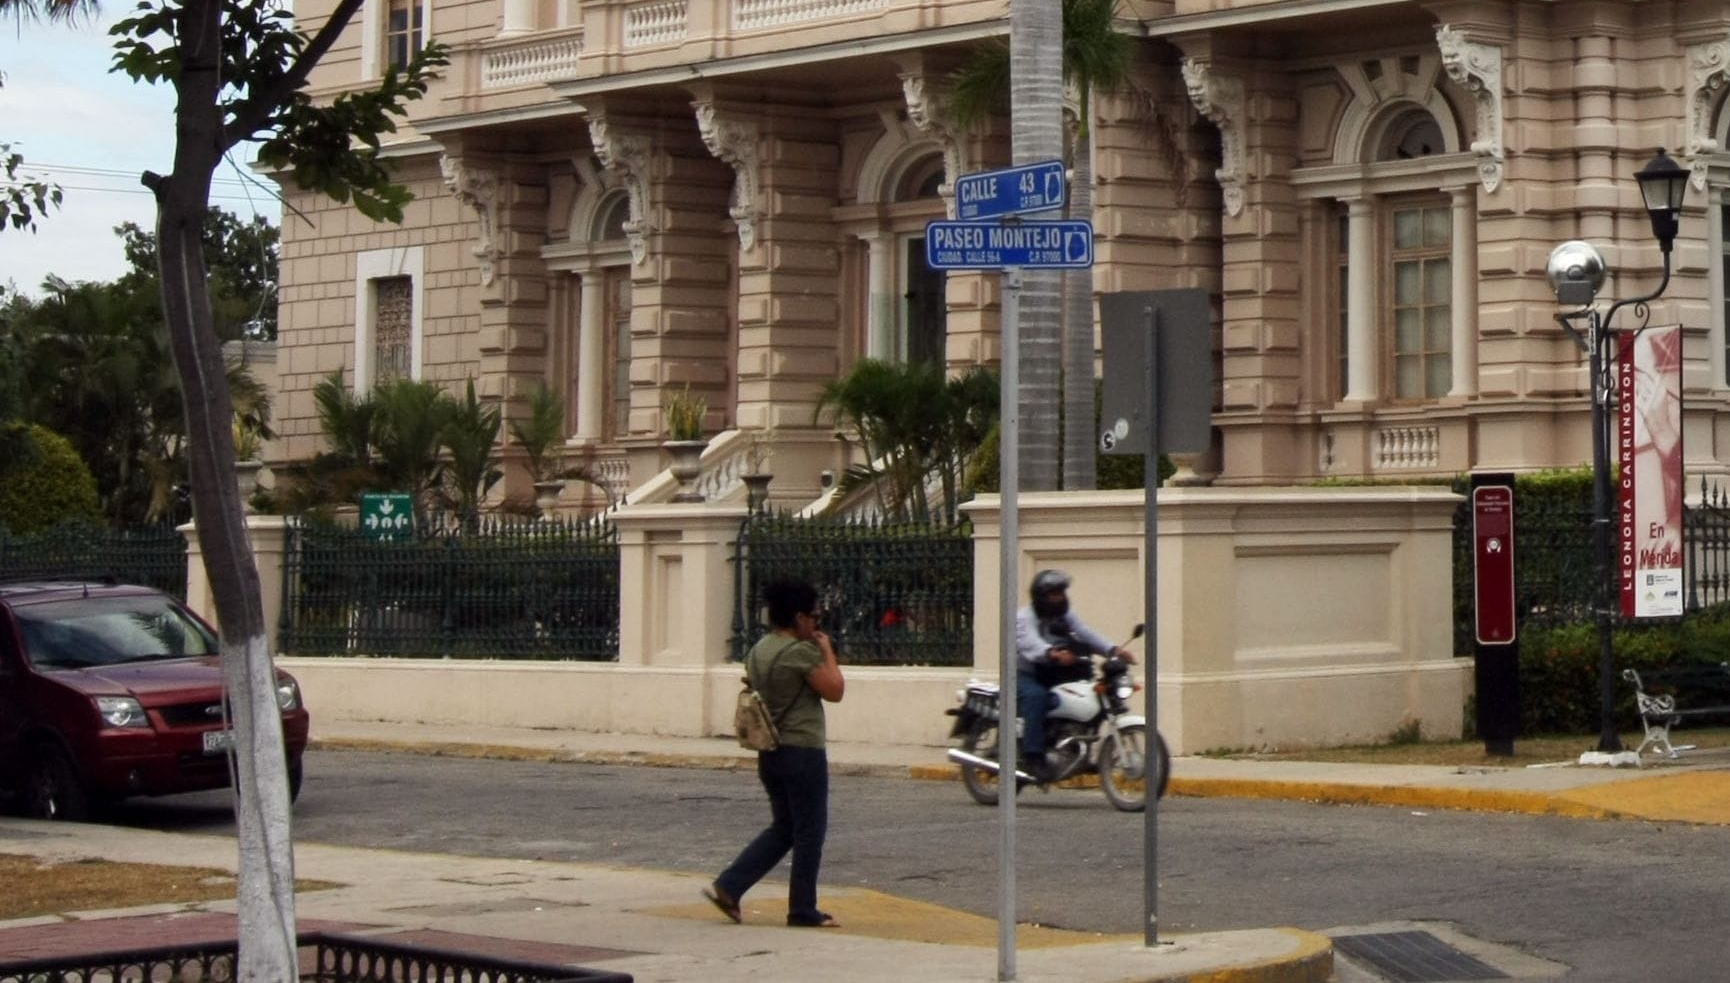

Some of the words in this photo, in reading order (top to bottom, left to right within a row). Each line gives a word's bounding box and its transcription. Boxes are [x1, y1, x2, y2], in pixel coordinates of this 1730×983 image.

[961, 178, 997, 203] CALLE
[1019, 172, 1035, 194] 43
[935, 228, 983, 249] PASEO
[989, 228, 1061, 249] MONTEJO
[1622, 363, 1632, 489] CARRINGTON
[1623, 499, 1632, 591] LEONORA
[1650, 522, 1664, 539] En
